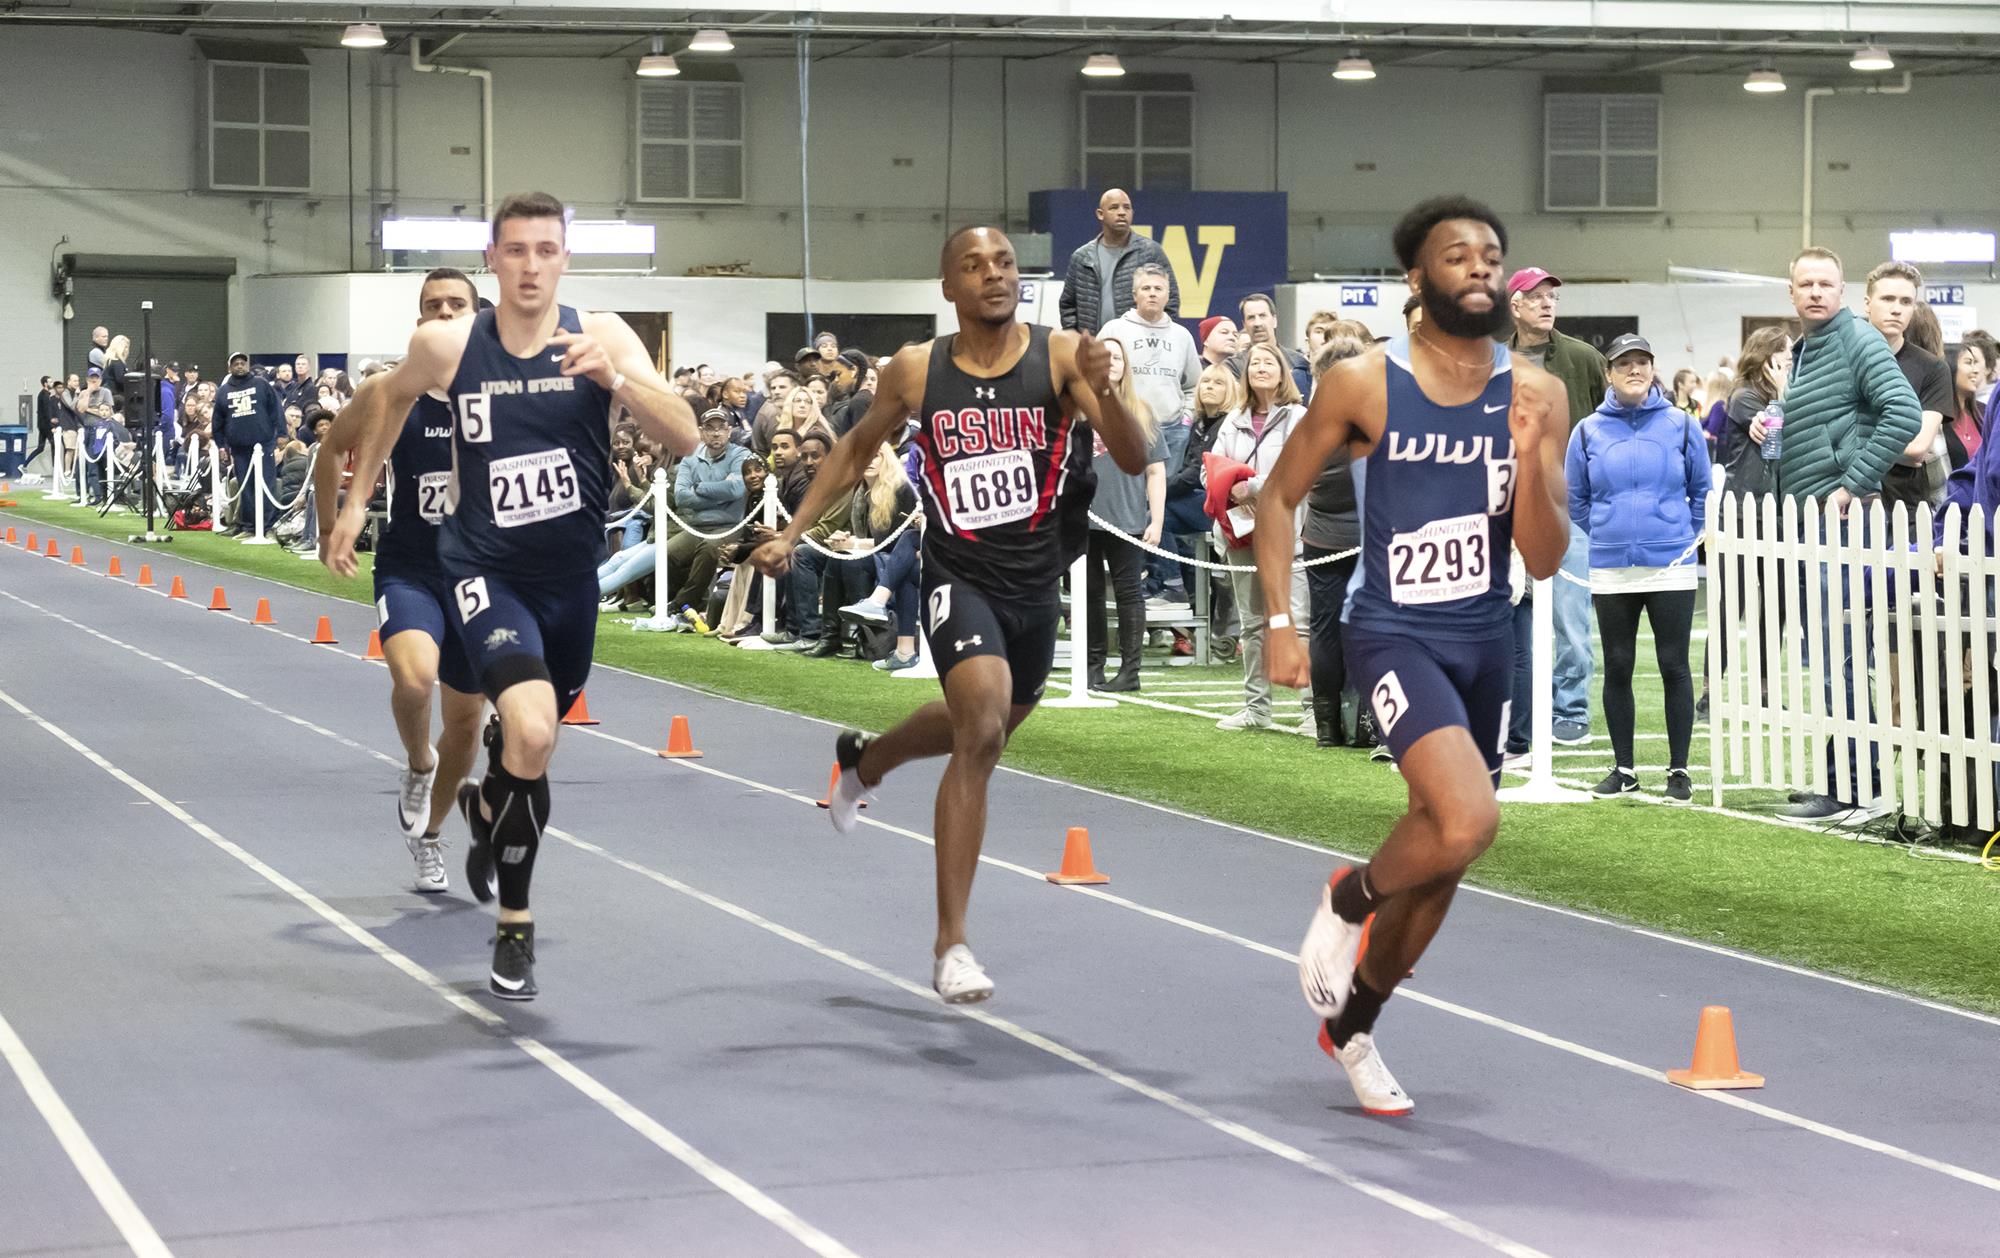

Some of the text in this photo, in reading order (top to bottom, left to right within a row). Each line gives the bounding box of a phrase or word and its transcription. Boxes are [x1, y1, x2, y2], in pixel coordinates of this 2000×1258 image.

[1131, 225, 1236, 319] W
[1343, 288, 1377, 303] PIT 1
[1926, 287, 1963, 303] PIT 2
[1133, 338, 1172, 352] EWU
[481, 377, 575, 395] UTAH STATE
[424, 426, 452, 438] WW
[465, 398, 484, 440] 5
[932, 407, 1047, 459] CSUN
[491, 453, 565, 473] WASHINGTON
[949, 453, 1024, 474] WASHINGTON
[1388, 431, 1516, 466] WWU
[492, 464, 575, 512] 2145
[951, 466, 1033, 514] 1689
[1494, 464, 1512, 513] 3
[1411, 518, 1483, 539] SHINGTON
[1393, 534, 1485, 586] 2293
[462, 577, 481, 617] 5
[932, 590, 944, 629] 2
[1376, 683, 1397, 725] 3
